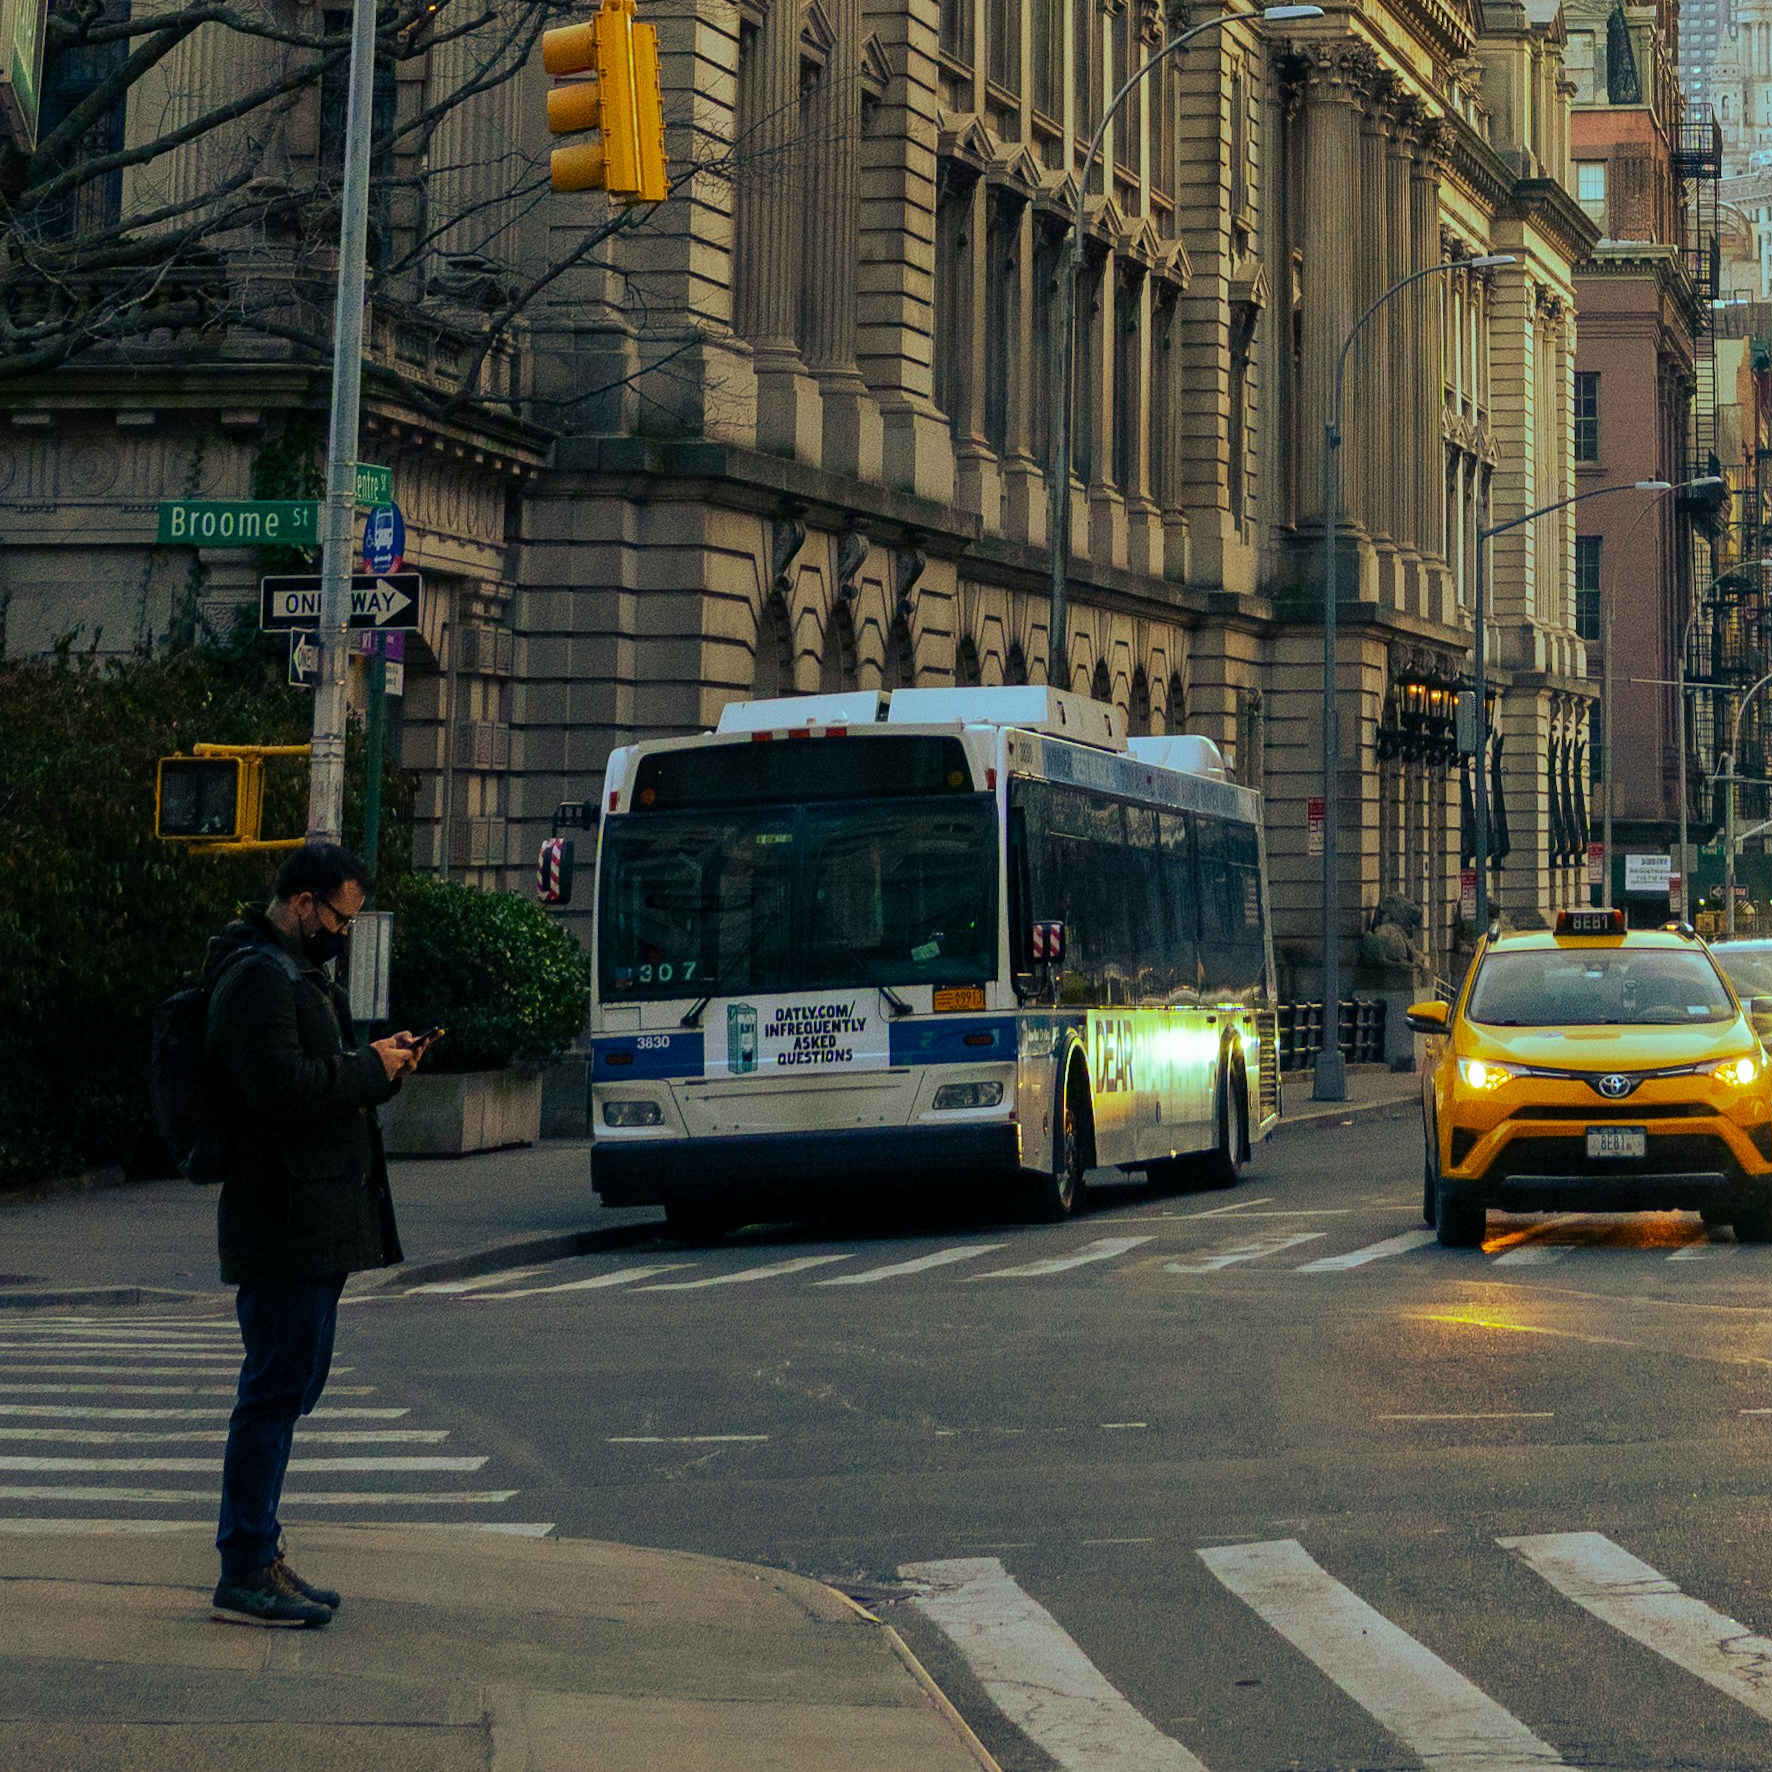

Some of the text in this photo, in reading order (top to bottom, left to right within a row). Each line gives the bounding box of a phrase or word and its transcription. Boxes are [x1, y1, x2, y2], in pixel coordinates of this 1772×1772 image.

[356, 473, 379, 502] entre
[171, 506, 309, 537] Broome St
[351, 592, 395, 613] WAY
[1573, 914, 1608, 930] 8E81
[775, 1000, 856, 1022] OATLY.COM/
[764, 1017, 867, 1038] INFREQUENTLY
[636, 1035, 670, 1050] 3830
[793, 1035, 837, 1051] ASKED
[777, 1048, 853, 1066] QUESTIONS
[1095, 1019, 1134, 1093] DEAR
